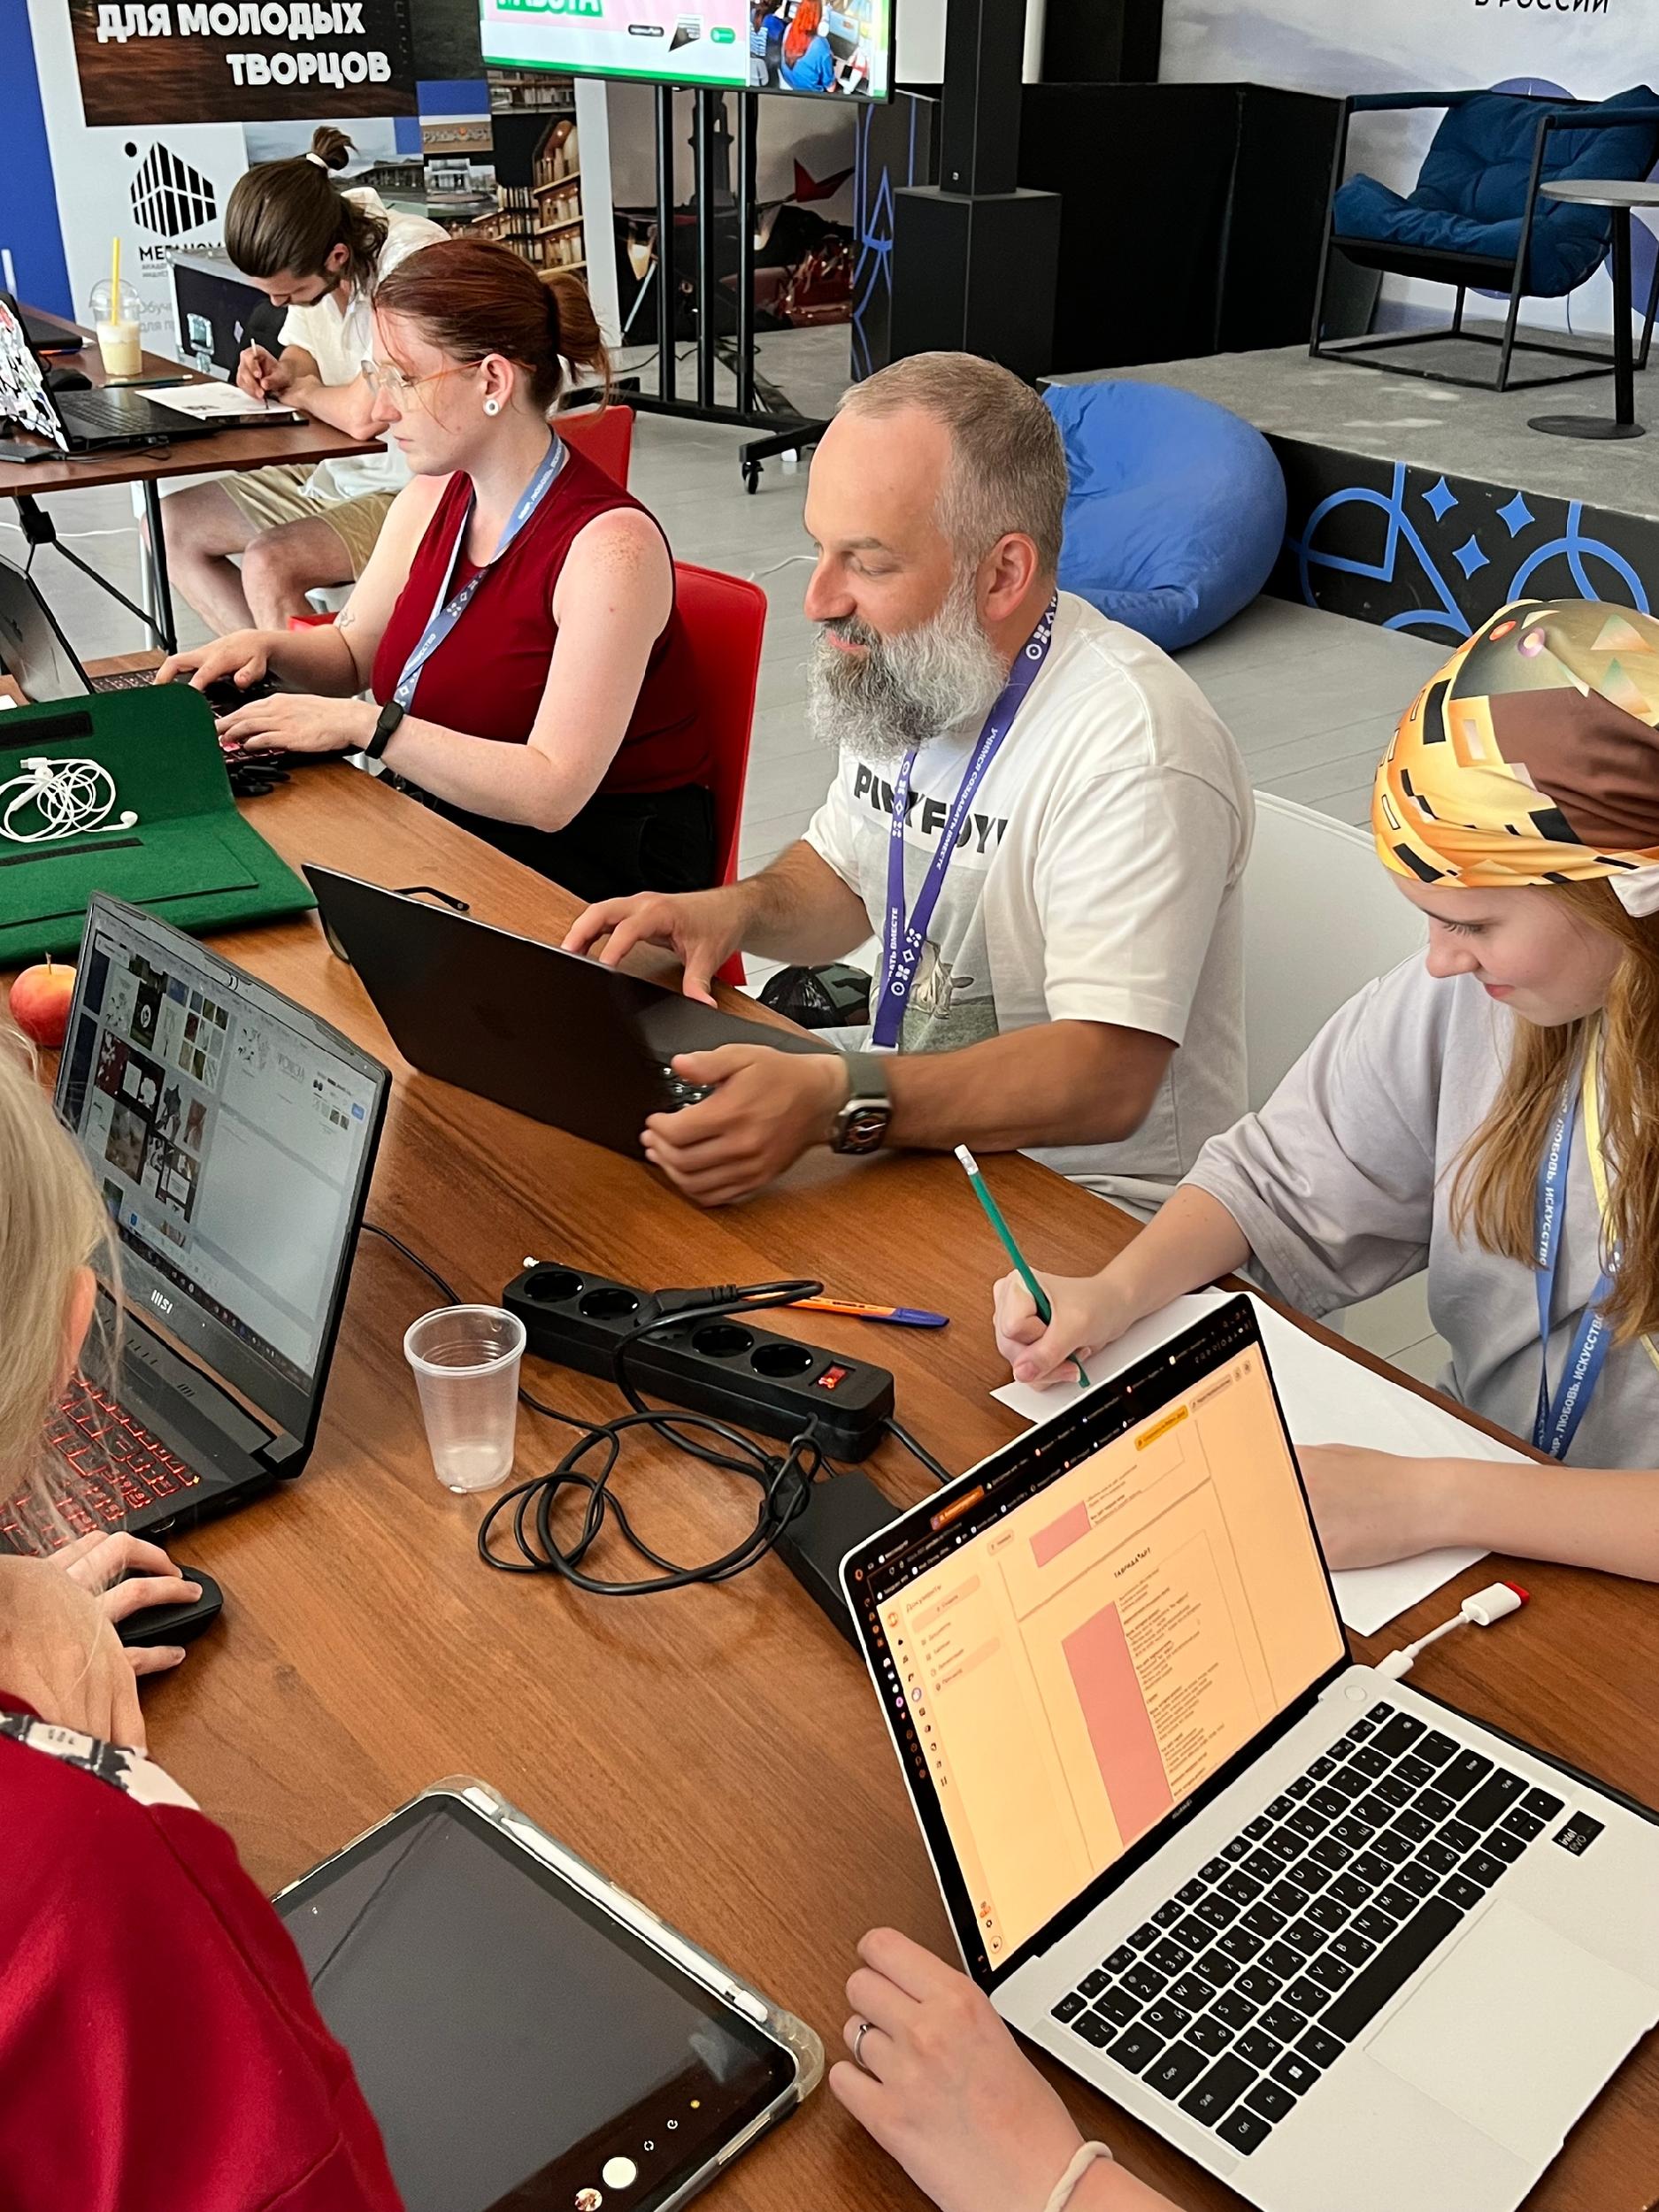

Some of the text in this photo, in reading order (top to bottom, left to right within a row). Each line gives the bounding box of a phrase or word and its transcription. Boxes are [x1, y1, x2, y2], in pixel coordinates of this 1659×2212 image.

[96, 3, 365, 42] ДЛЯ МОЛОДЫХ
[226, 51, 391, 89] ТВОРЦОВ
[1540, 1187, 1555, 1265] ИСКУССТВО
